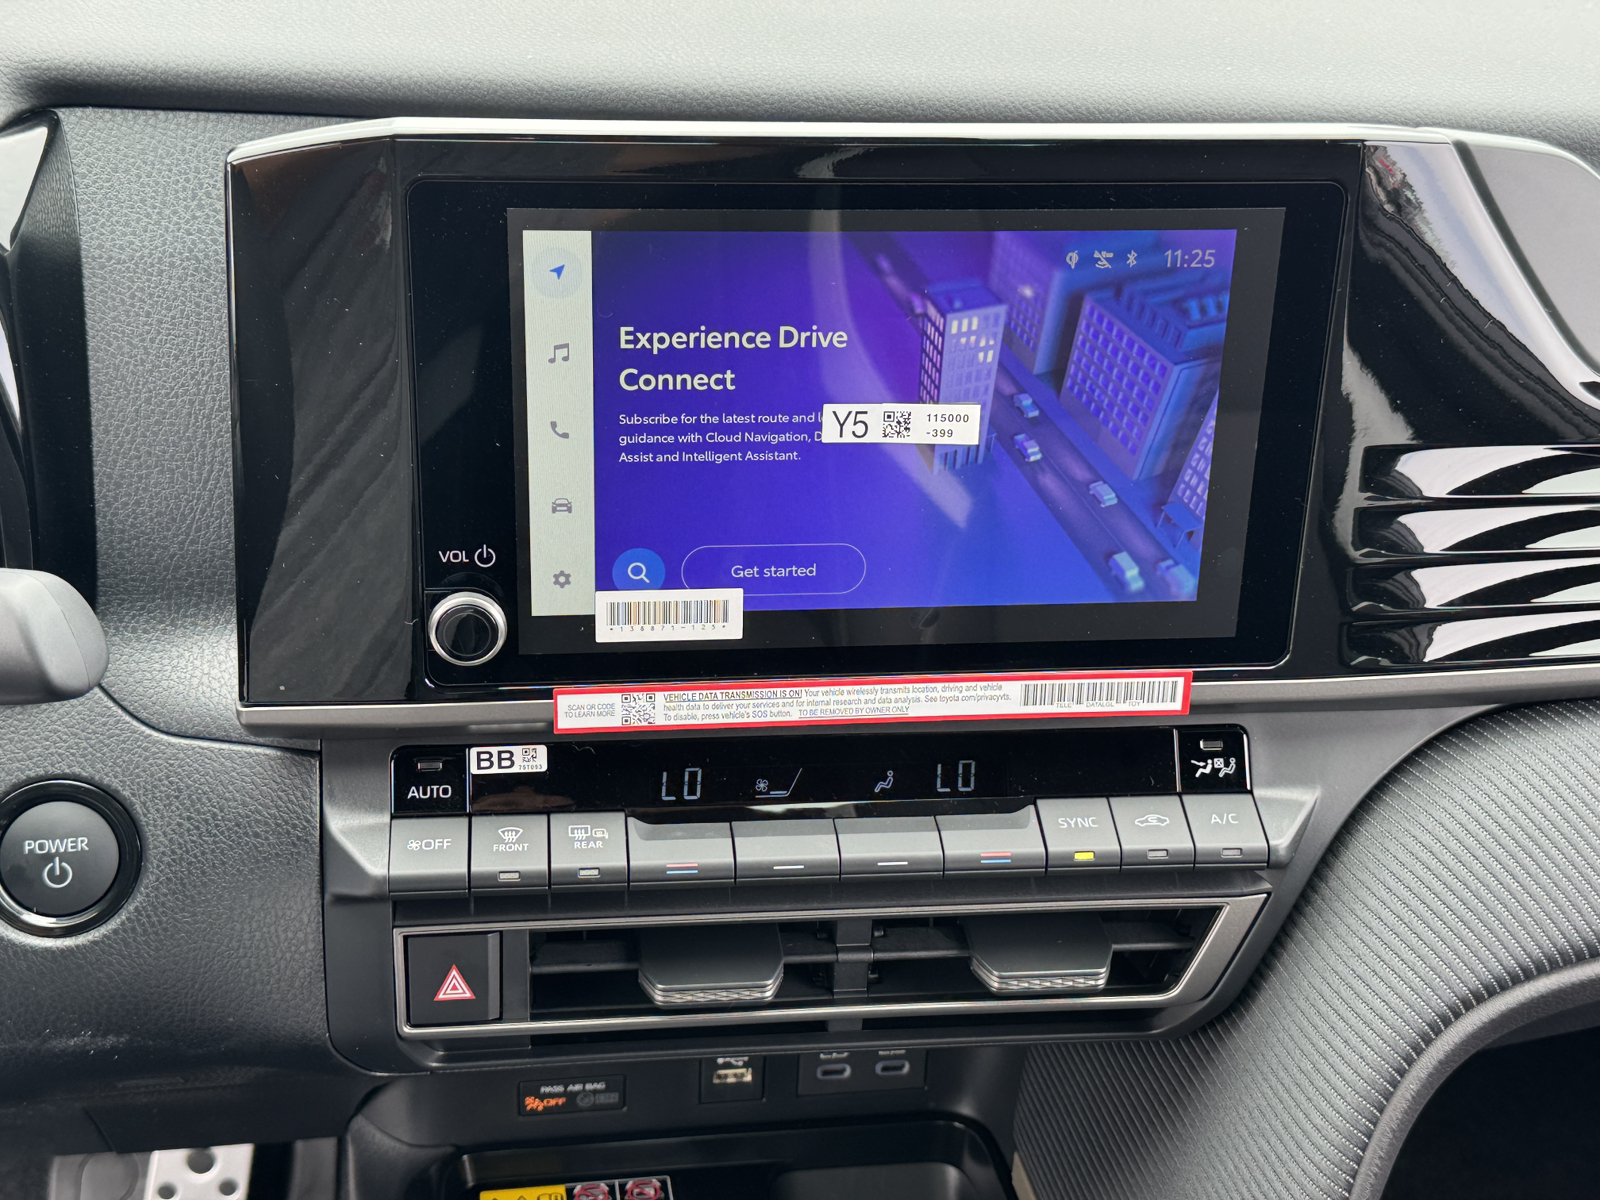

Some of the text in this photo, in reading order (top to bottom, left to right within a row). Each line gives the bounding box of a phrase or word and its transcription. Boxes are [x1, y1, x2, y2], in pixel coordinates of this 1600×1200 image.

[1164, 249, 1216, 268] 11:25
[619, 324, 849, 355] Experience Drive
[618, 367, 736, 391] Connect
[619, 413, 679, 425] Subscribe
[681, 412, 697, 424] for
[700, 412, 719, 424] the
[722, 412, 756, 424] latest
[757, 412, 789, 424] route
[792, 411, 815, 423] and
[832, 410, 869, 439] Y5
[926, 413, 970, 423] 115000
[619, 432, 675, 447] guidance
[678, 432, 703, 443] with
[705, 431, 742, 443] Cloud
[744, 430, 812, 444] Navigation,
[926, 429, 954, 438] -399
[619, 450, 802, 464] Assist and Intelligent Assistant.
[438, 550, 470, 563] VOL
[730, 563, 817, 578] Get started
[663, 692, 697, 701] VEHICLE
[698, 691, 719, 700] DATA
[720, 690, 778, 699] TRANSMISSION
[779, 690, 787, 698] IS
[804, 688, 820, 697] Your
[821, 687, 845, 696] vehicle
[846, 686, 878, 696] wirelessly
[880, 686, 910, 694] transmits
[911, 684, 940, 693] location,
[941, 684, 963, 693] driving
[964, 683, 978, 692] and
[979, 682, 1003, 691] vehicle
[567, 702, 616, 711] SCAN QR CODE
[663, 703, 684, 711] health
[685, 703, 701, 711] data
[711, 702, 734, 710] deliver
[735, 702, 751, 711] your
[751, 700, 780, 709] services
[781, 700, 794, 708] and
[795, 699, 805, 707] for
[806, 698, 832, 706] internal
[832, 697, 862, 706] research
[863, 697, 877, 705] and
[877, 696, 892, 704] data
[893, 695, 923, 705] analysis.
[924, 694, 938, 703] See
[663, 705, 910, 721] To disable, press vehicle's SOS button. TO BE REMOVED BY OWNER ONLY
[476, 750, 516, 771] BB
[407, 785, 452, 799] AUTO
[1058, 816, 1099, 828] SYNC
[1210, 813, 1239, 825] A/C
[23, 837, 90, 854] POWER
[421, 838, 452, 850] OFF
[493, 843, 530, 852] FRONT
[574, 840, 604, 849] REAR
